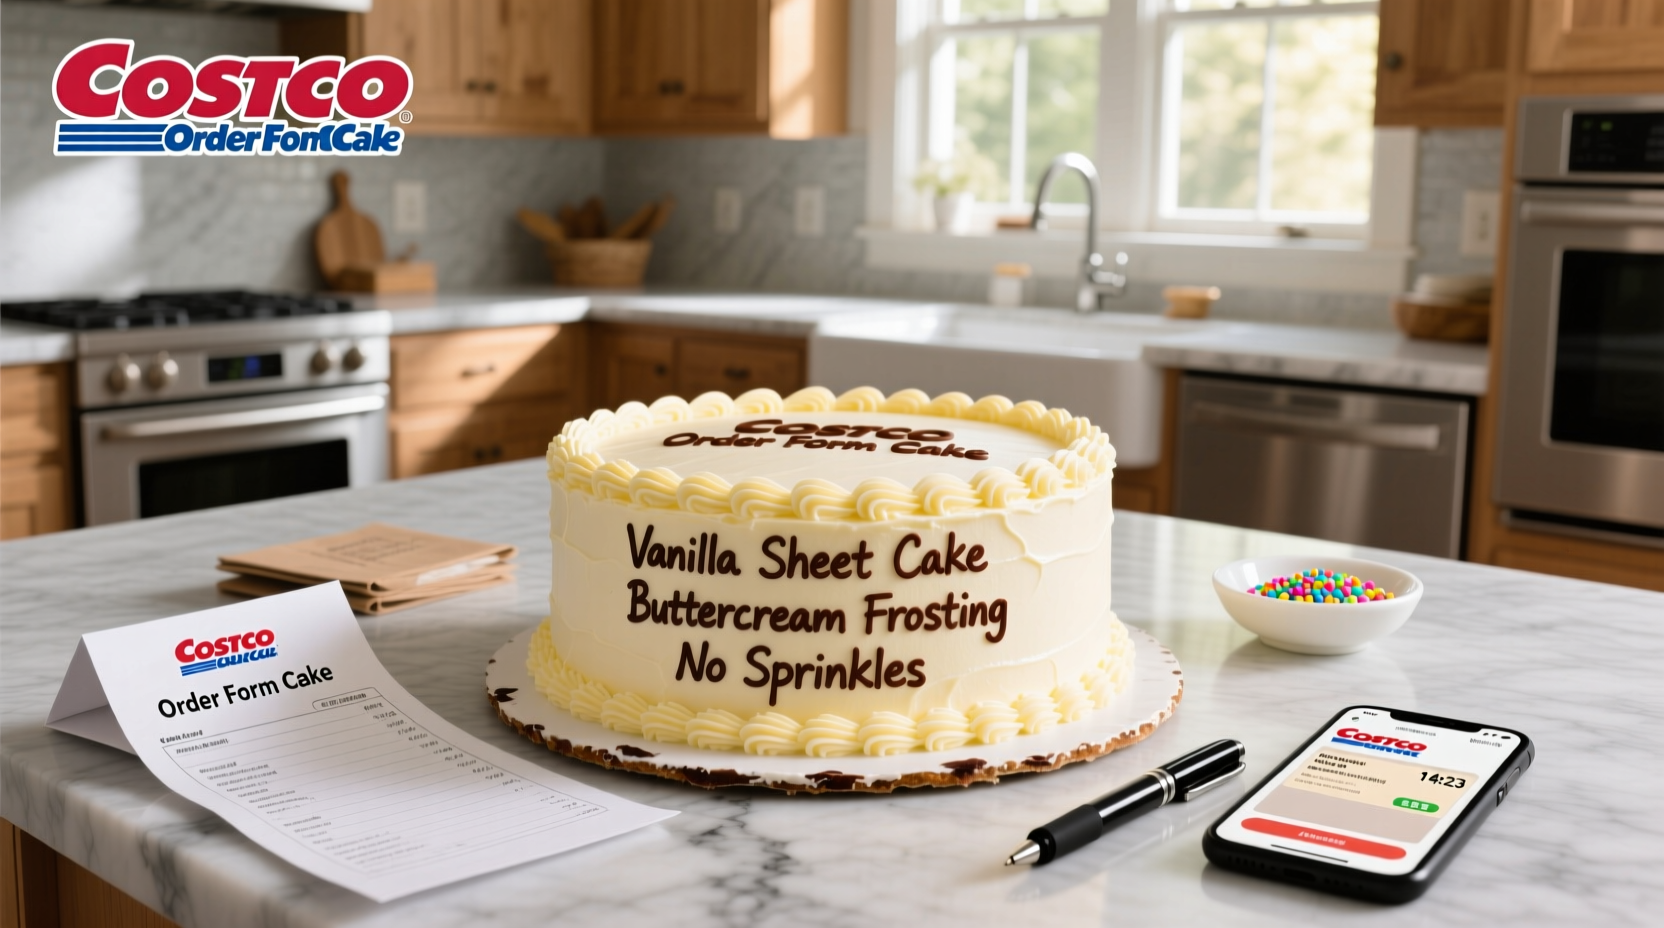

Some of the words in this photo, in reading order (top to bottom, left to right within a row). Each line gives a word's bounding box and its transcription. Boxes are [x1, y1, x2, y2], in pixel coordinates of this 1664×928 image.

[662, 432, 777, 447] Order
[782, 435, 878, 452] Form
[890, 441, 990, 461] Cake
[627, 523, 741, 575] Vanilla
[759, 535, 873, 579] Sheet
[893, 531, 989, 579] Cake
[626, 579, 846, 634] Buttercream
[864, 593, 1007, 642] Frosting
[158, 692, 218, 717] Order
[223, 680, 280, 704] Form
[282, 664, 334, 690] Cake
[676, 641, 726, 682] No
[744, 645, 925, 706] Sprinkles
[1420, 771, 1466, 789] 14:23
